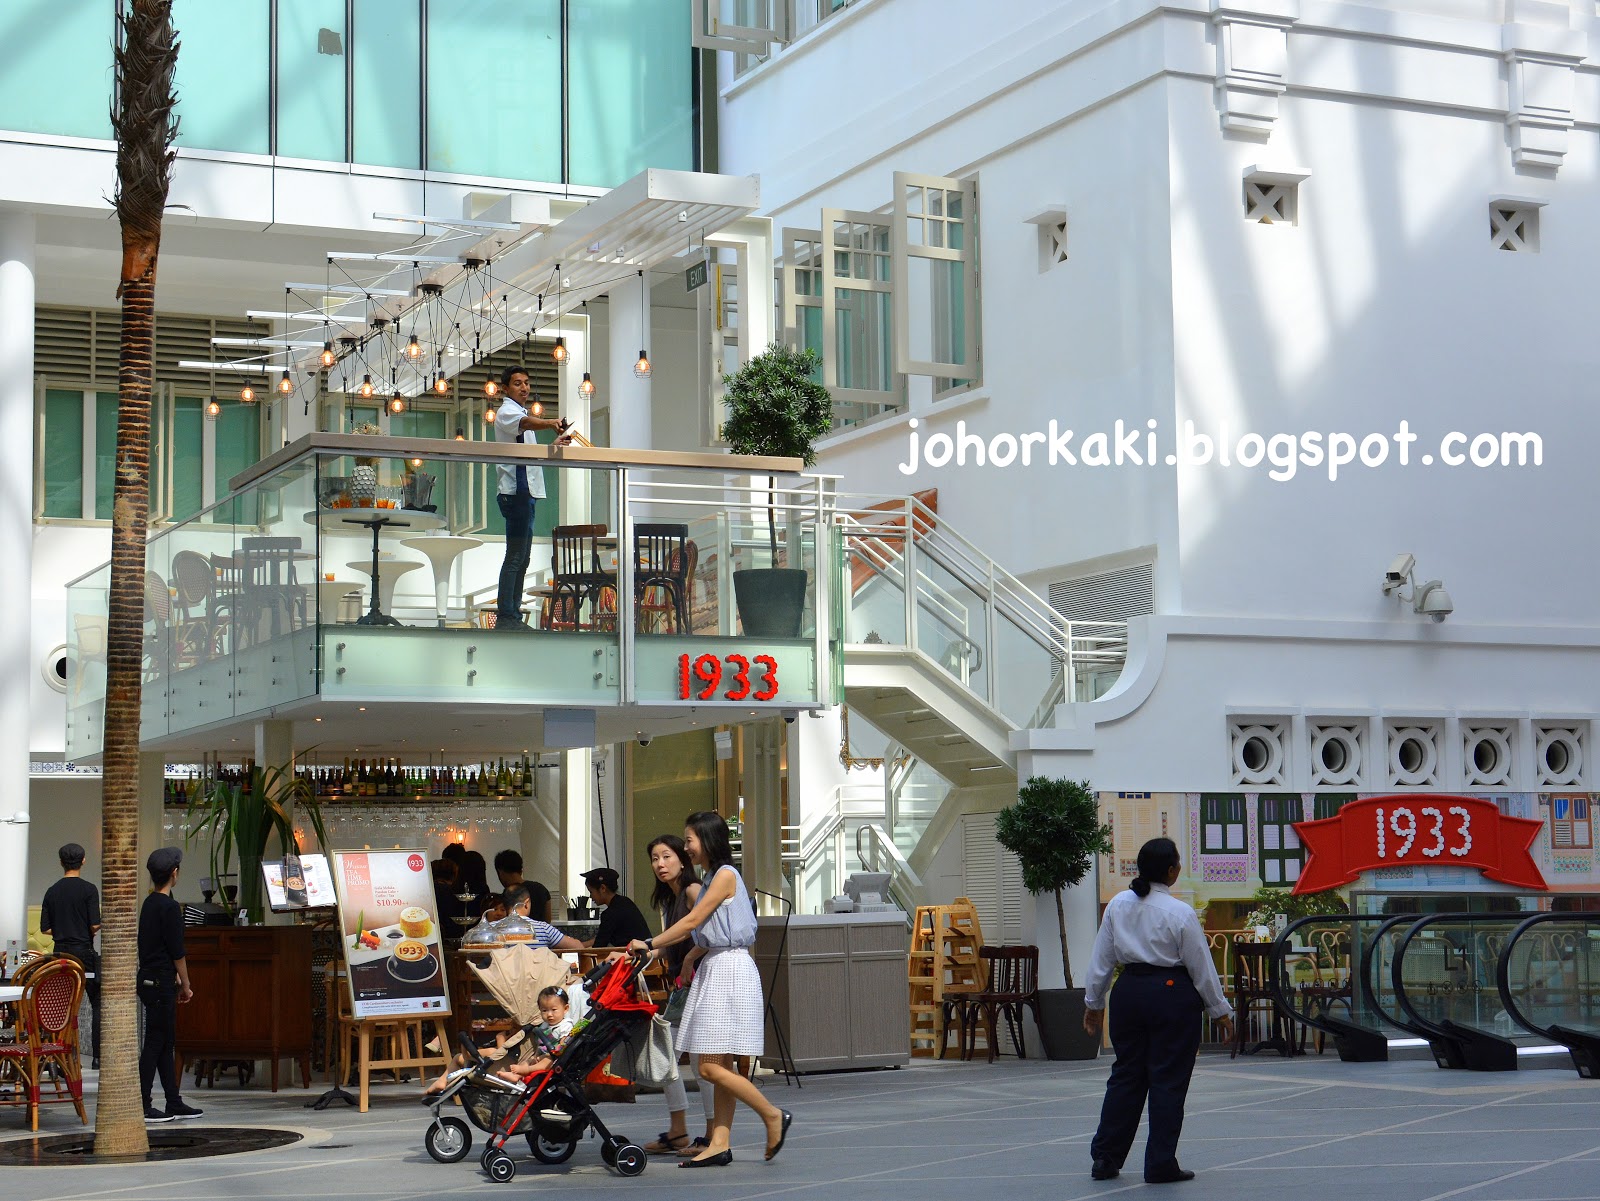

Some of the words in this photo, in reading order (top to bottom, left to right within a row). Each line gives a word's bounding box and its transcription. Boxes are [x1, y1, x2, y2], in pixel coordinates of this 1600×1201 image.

[690, 266, 703, 287] EXIT
[678, 653, 779, 700] 1933
[1376, 806, 1472, 858] 1933
[408, 859, 424, 868] 1933
[399, 946, 423, 955] 1933
